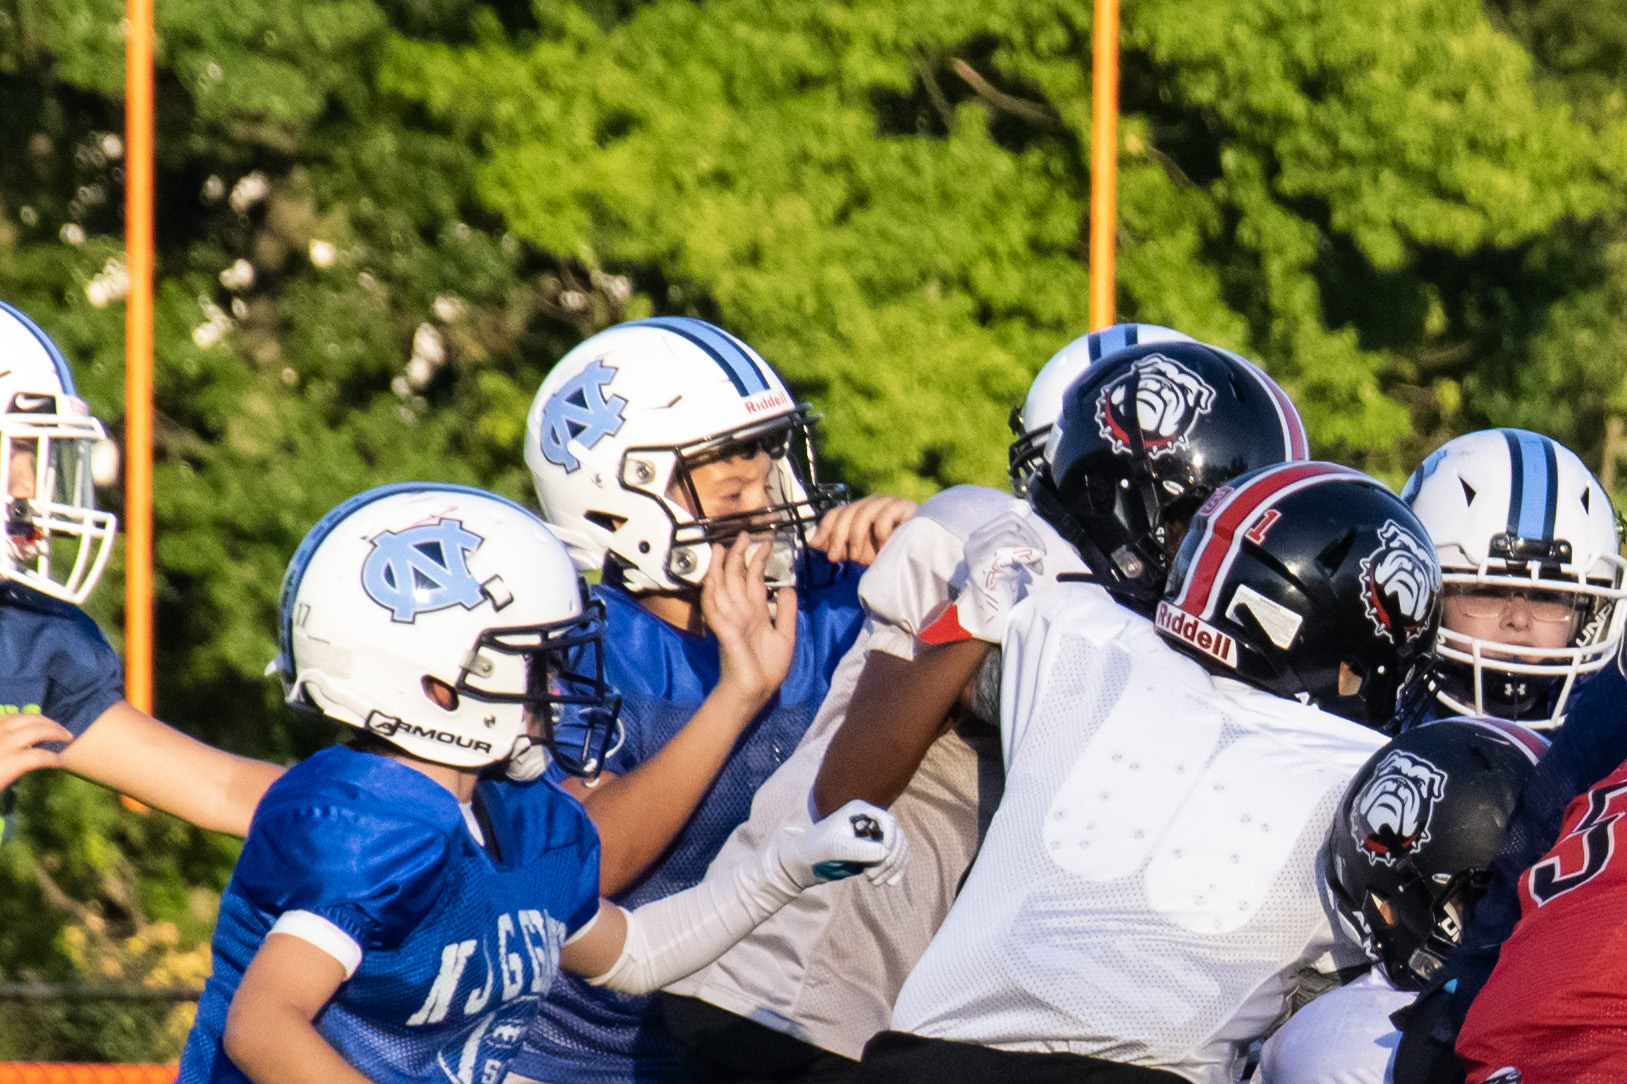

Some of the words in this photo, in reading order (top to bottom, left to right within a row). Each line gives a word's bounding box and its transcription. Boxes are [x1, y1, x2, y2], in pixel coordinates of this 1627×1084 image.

[744, 393, 788, 414] Riddell
[1245, 508, 1282, 546] 1
[1157, 600, 1232, 661] Riddell
[1576, 602, 1613, 648] UND
[374, 716, 493, 755] ARMOUR
